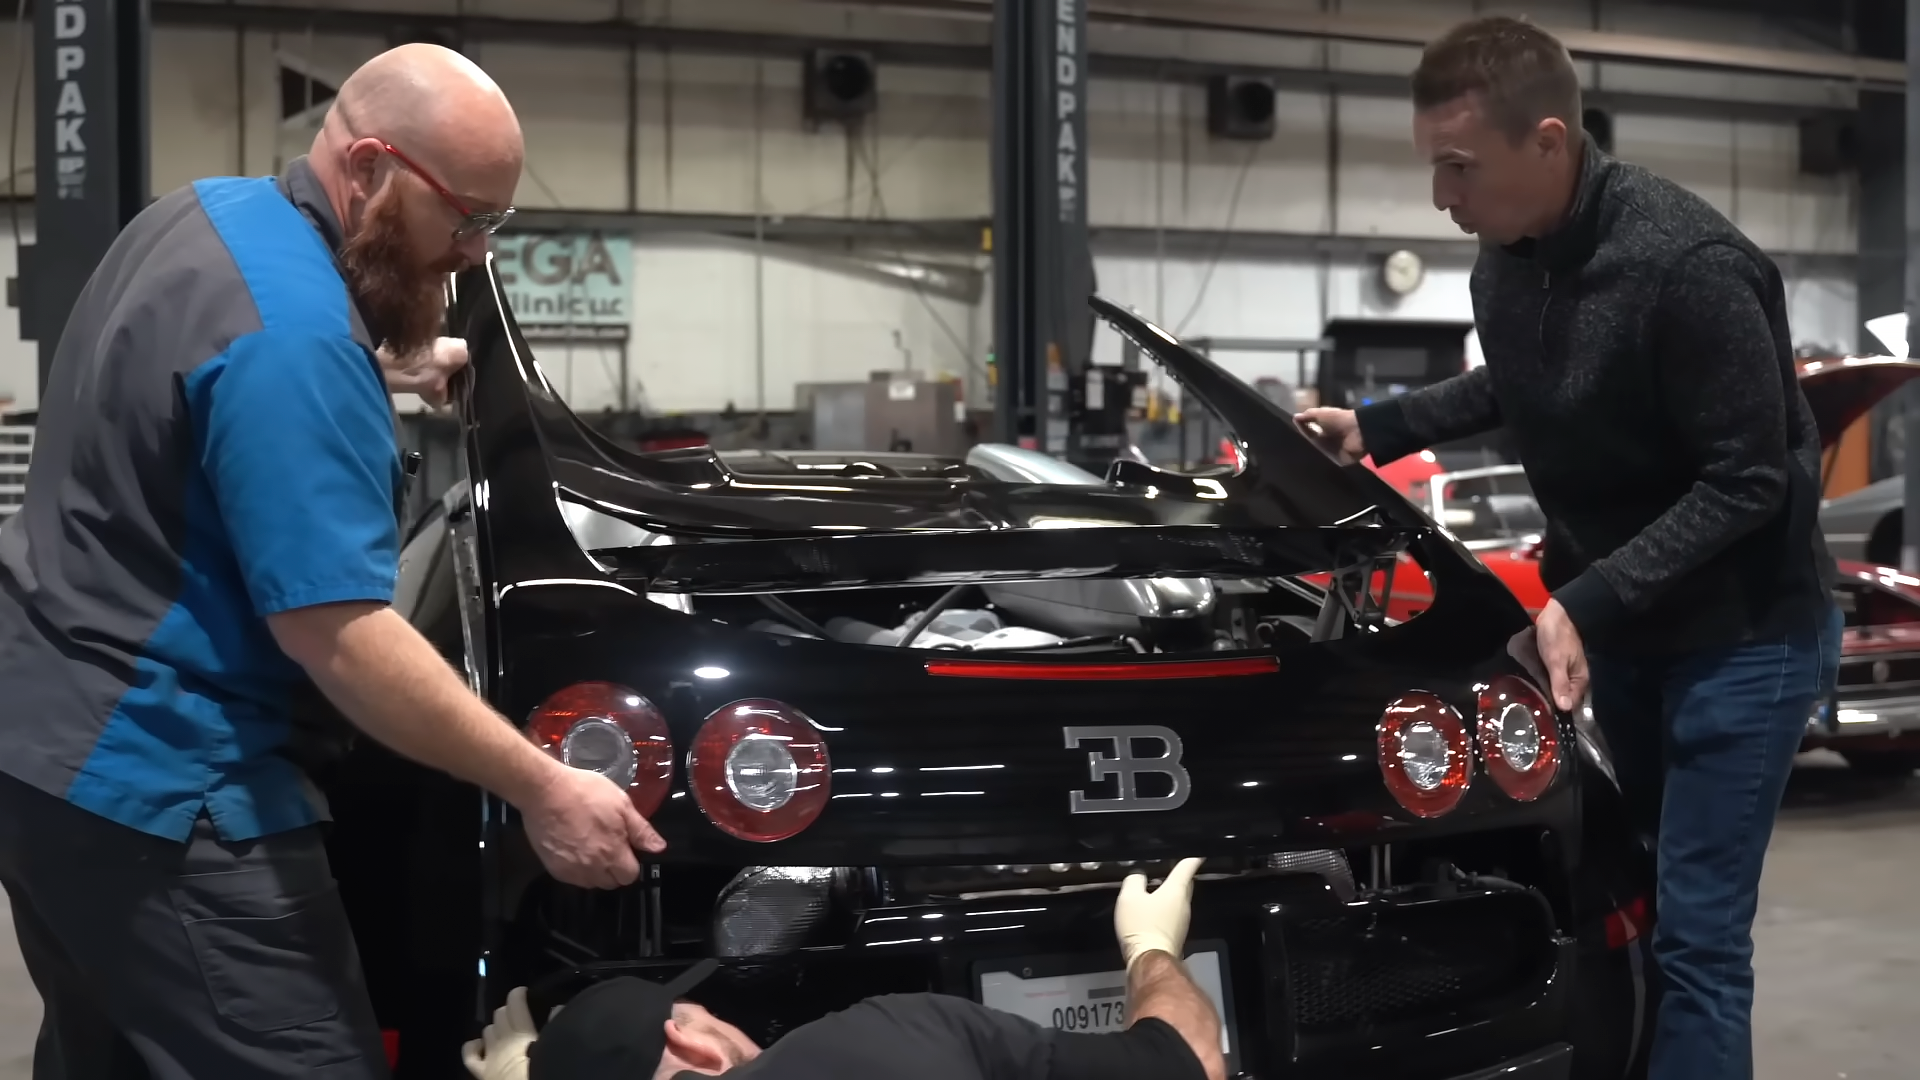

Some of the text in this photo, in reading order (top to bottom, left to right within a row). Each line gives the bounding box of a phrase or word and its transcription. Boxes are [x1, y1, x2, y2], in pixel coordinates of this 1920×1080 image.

[55, 0, 86, 153] DPAK
[508, 291, 585, 317] linic
[1052, 1000, 1125, 1031] 009173
